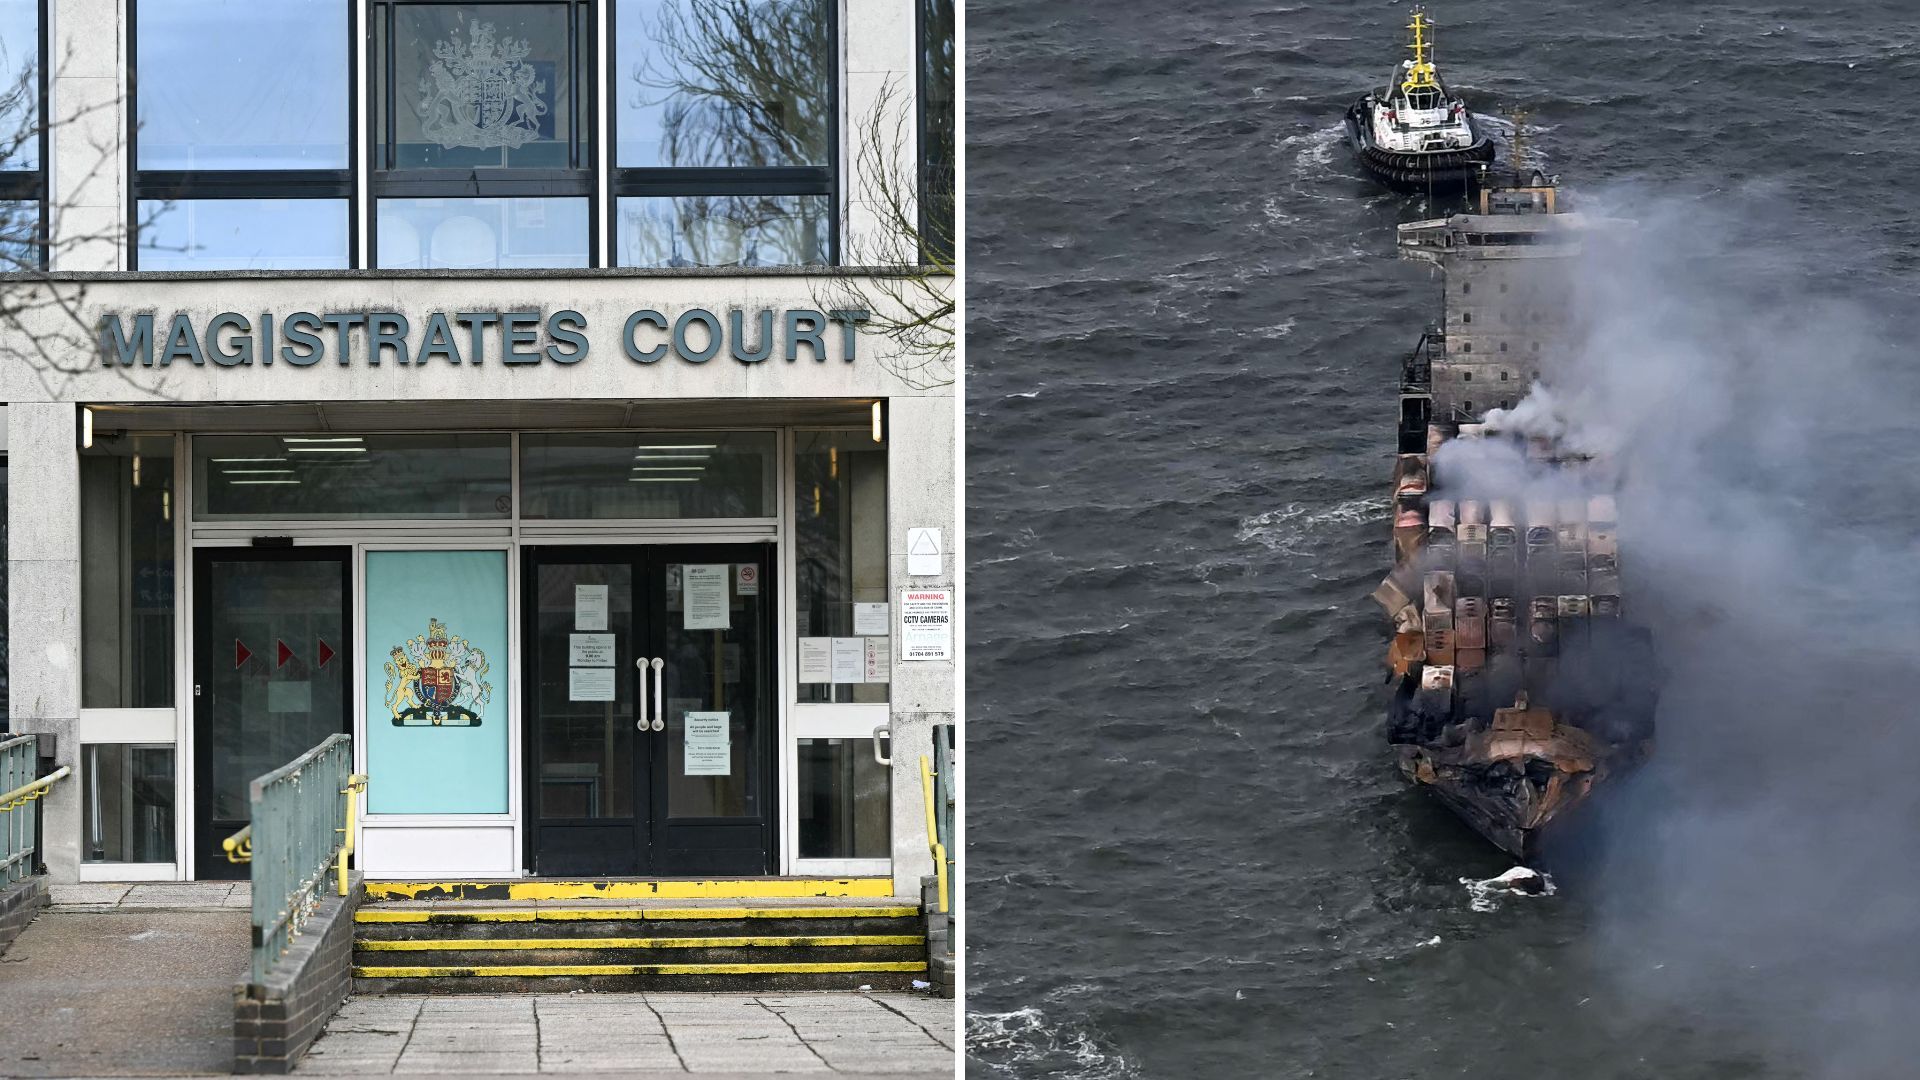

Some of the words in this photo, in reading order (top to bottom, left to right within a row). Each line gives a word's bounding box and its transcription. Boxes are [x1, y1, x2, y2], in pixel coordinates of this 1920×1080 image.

[102, 309, 590, 366] MAGISTRATES
[622, 308, 870, 364] COURT
[903, 615, 919, 624] CCTV
[919, 615, 949, 624] CAMERAS
